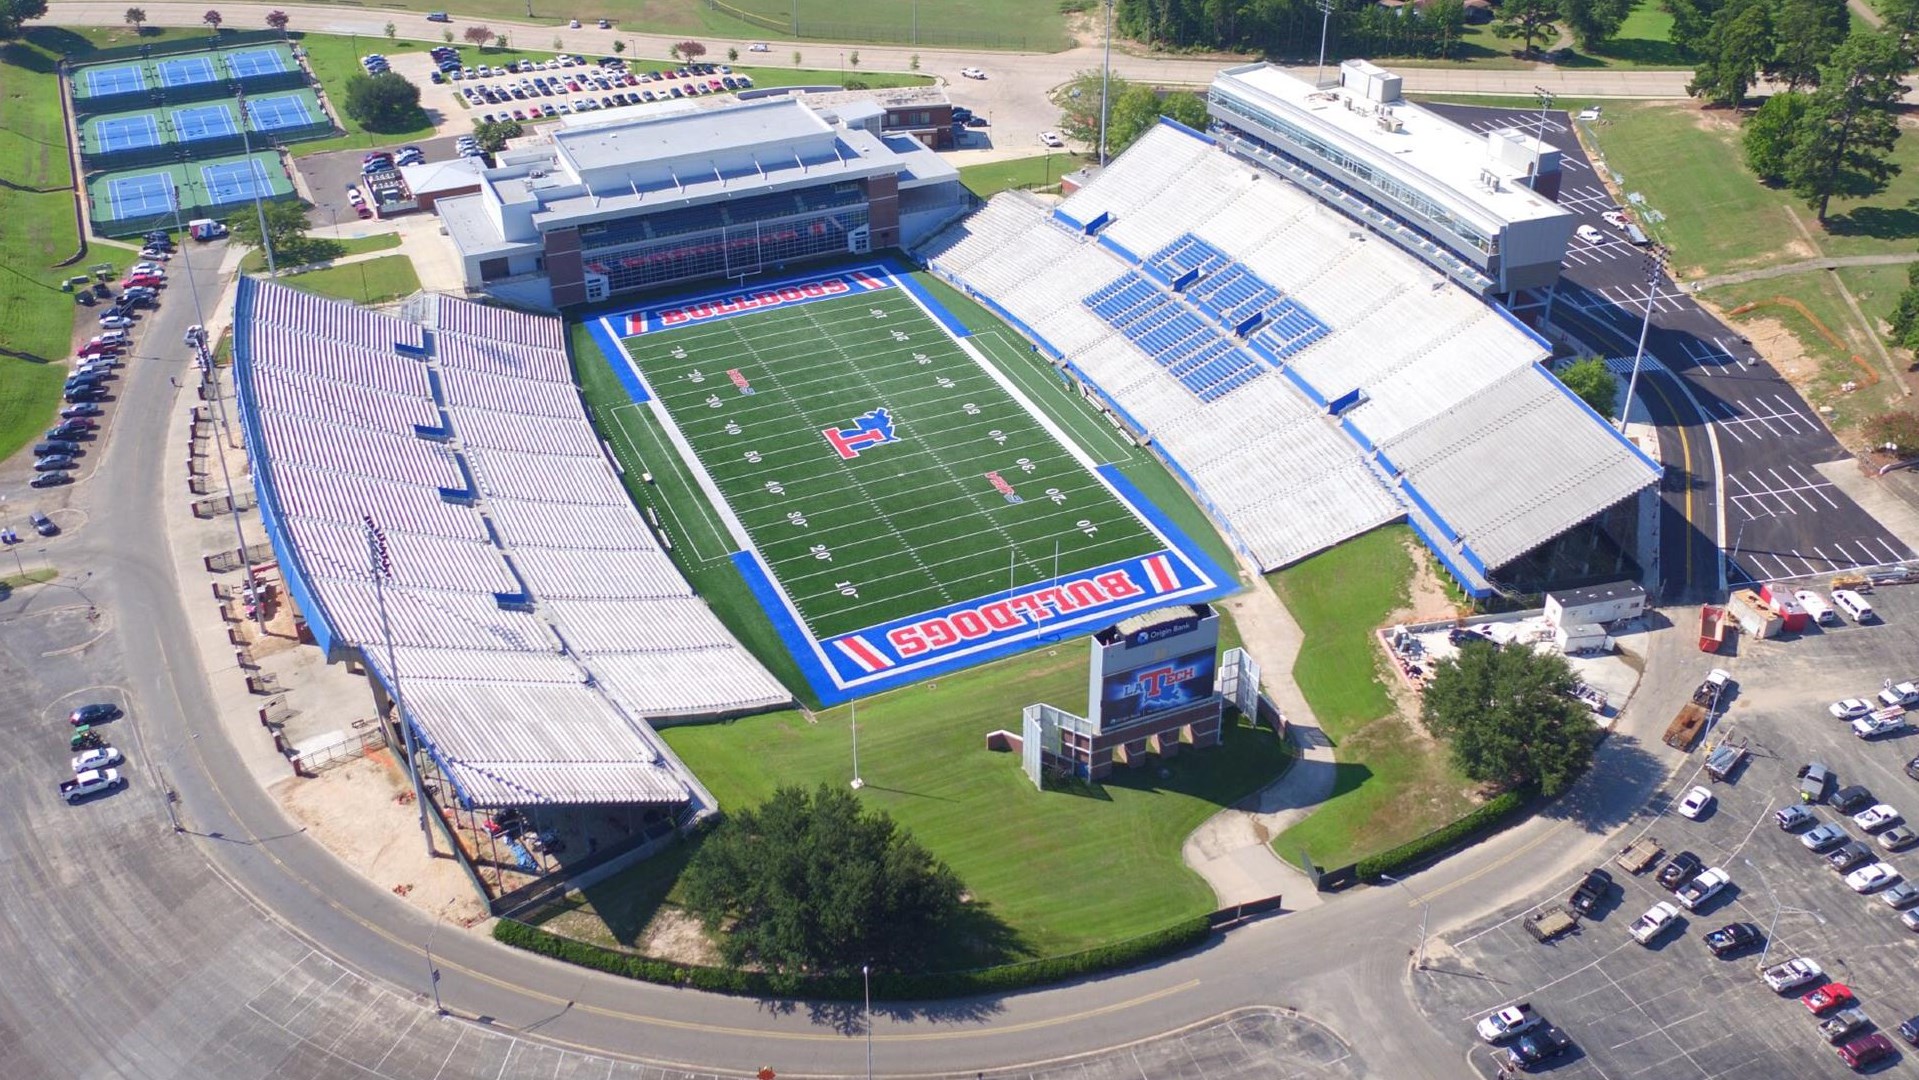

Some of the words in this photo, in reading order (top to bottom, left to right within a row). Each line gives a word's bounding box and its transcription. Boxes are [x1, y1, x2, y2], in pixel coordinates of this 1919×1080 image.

[656, 278, 850, 326] BULLDOGS
[962, 403, 981, 415] 50
[743, 450, 762, 463] 50
[1015, 458, 1036, 471] 30
[764, 481, 784, 494] 40
[1045, 488, 1068, 502] 20
[786, 511, 807, 526] 30
[1076, 520, 1098, 534] 10
[808, 544, 831, 560] 20
[834, 580, 857, 596] 10
[886, 568, 1146, 659] BULLDOGS
[1150, 627, 1172, 638] Origin
